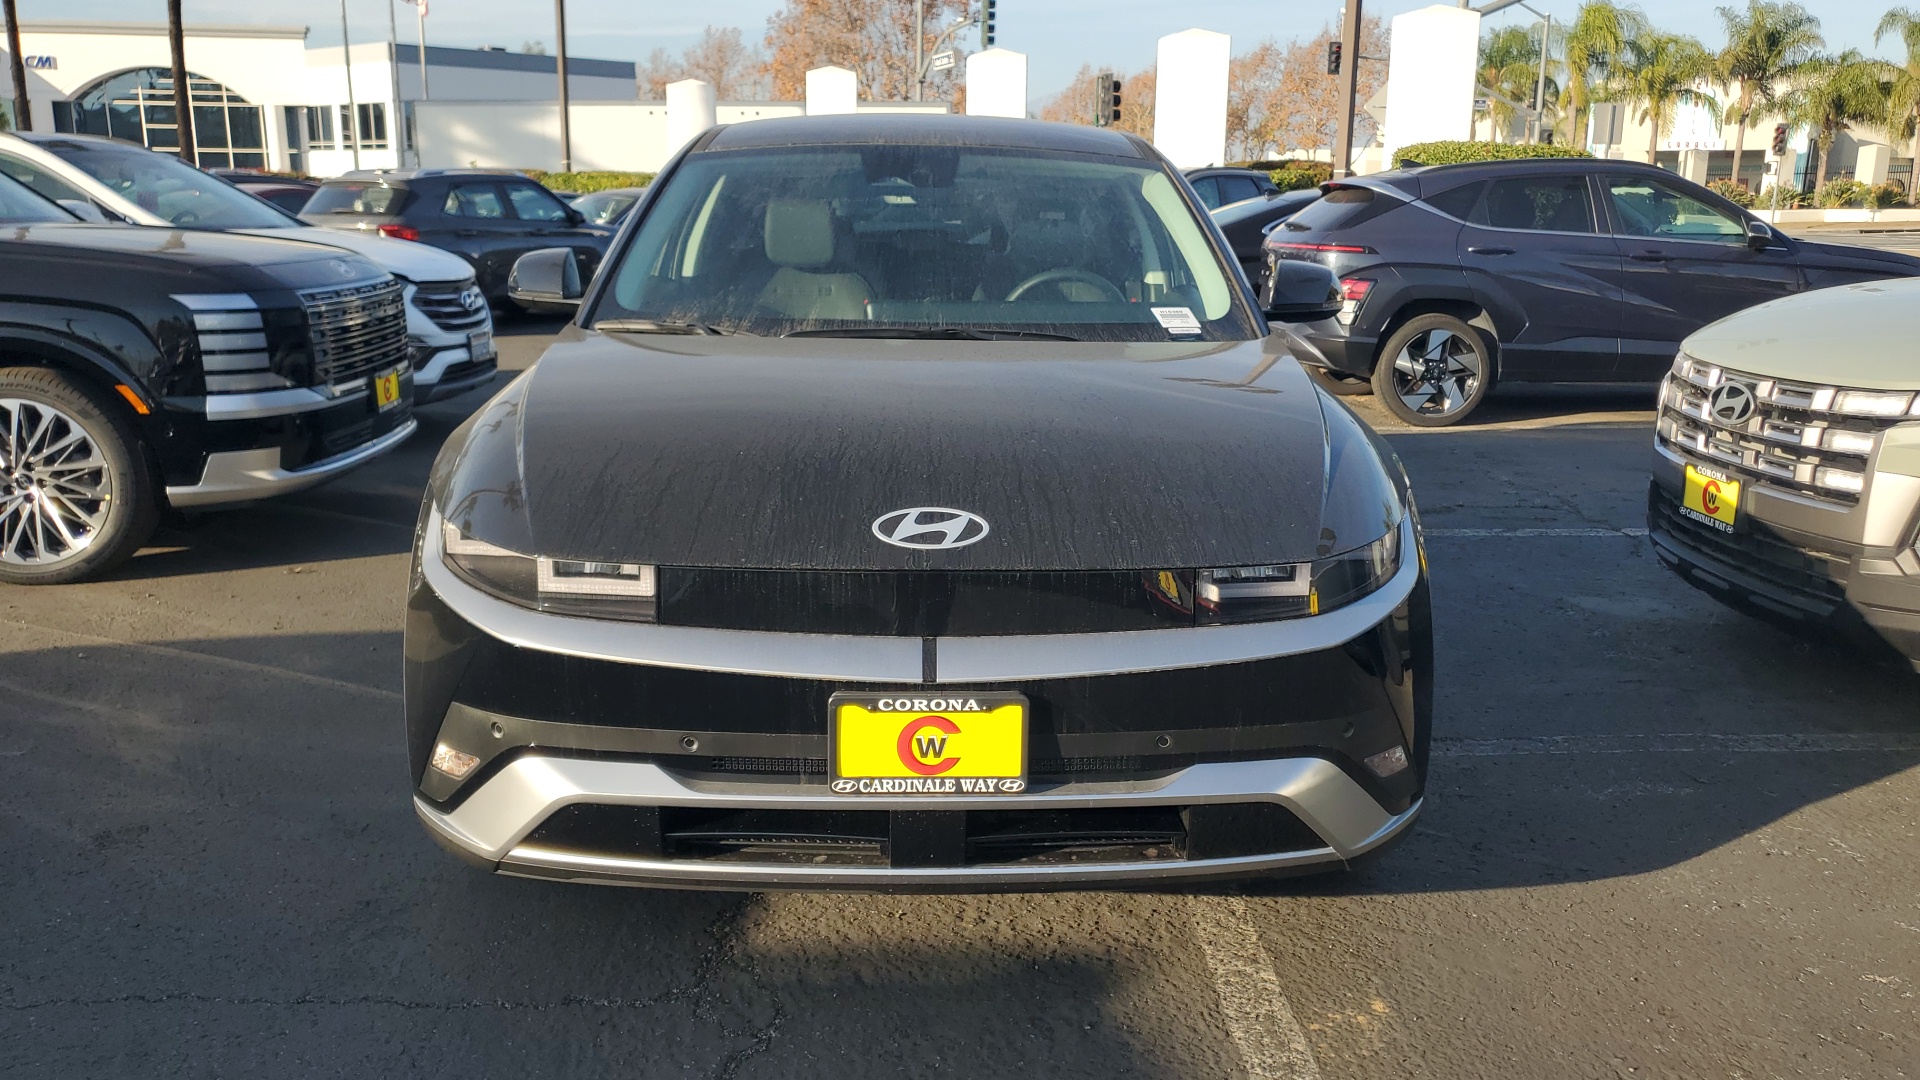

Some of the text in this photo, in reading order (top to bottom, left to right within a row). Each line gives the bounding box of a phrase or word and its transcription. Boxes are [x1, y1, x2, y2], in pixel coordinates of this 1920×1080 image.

[1697, 466, 1727, 483] CORONA
[1686, 509, 1726, 532] CARDINALE WAY
[877, 698, 981, 712] CORONA
[859, 779, 999, 793] CARDINALE WAY
